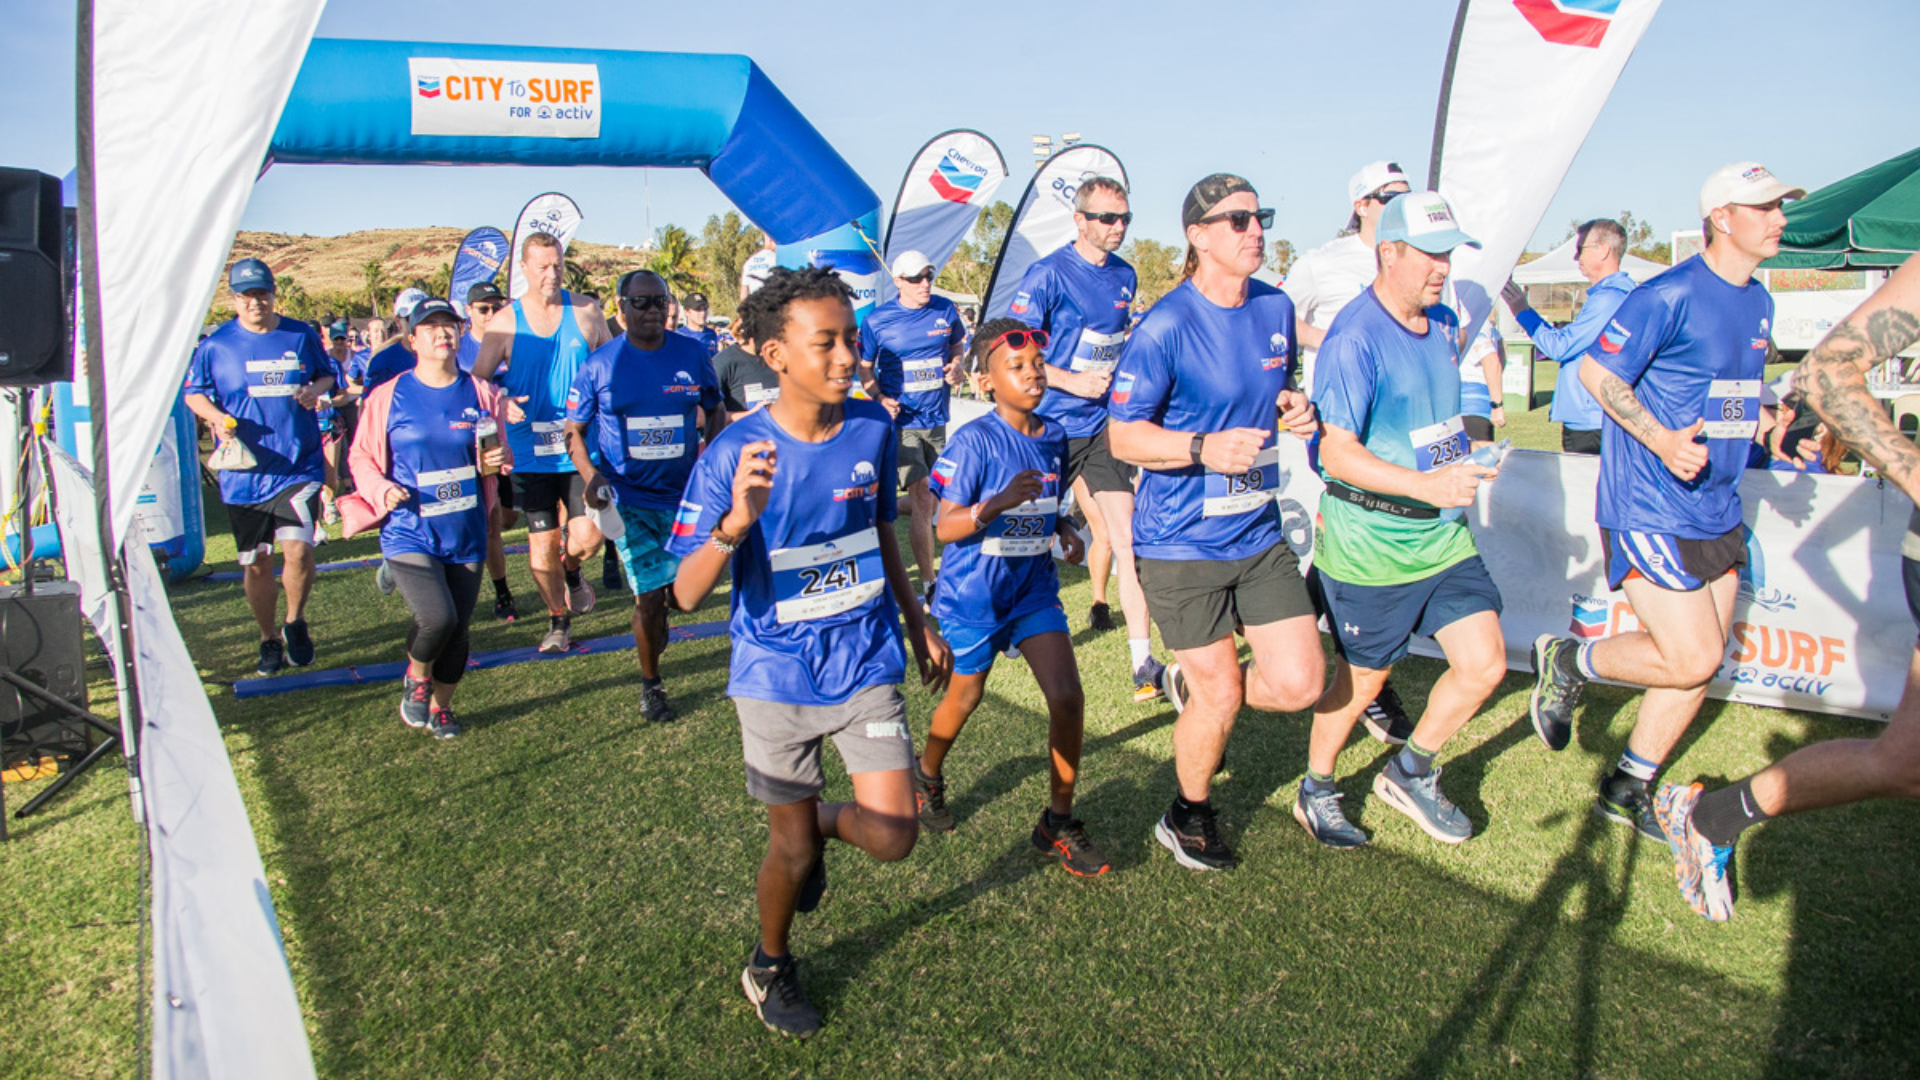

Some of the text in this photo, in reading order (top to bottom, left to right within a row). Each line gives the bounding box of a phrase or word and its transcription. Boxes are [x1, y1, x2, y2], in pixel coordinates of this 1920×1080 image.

[445, 74, 504, 101] CITY
[527, 78, 594, 104] SURF
[509, 106, 593, 120] FOR activ
[947, 147, 989, 177] Chevron
[529, 218, 566, 239] activ
[262, 371, 285, 385] 67
[1722, 398, 1744, 420] 65
[638, 429, 673, 446] 257
[1429, 437, 1462, 467] 232
[437, 482, 461, 500] 68
[845, 486, 864, 499] CITY
[1224, 469, 1263, 495] 139
[1002, 517, 1045, 537] 252
[798, 558, 859, 597] 241
[1572, 593, 1608, 606] Chevron
[1730, 621, 1846, 676] SURF
[1762, 673, 1833, 695] activ
